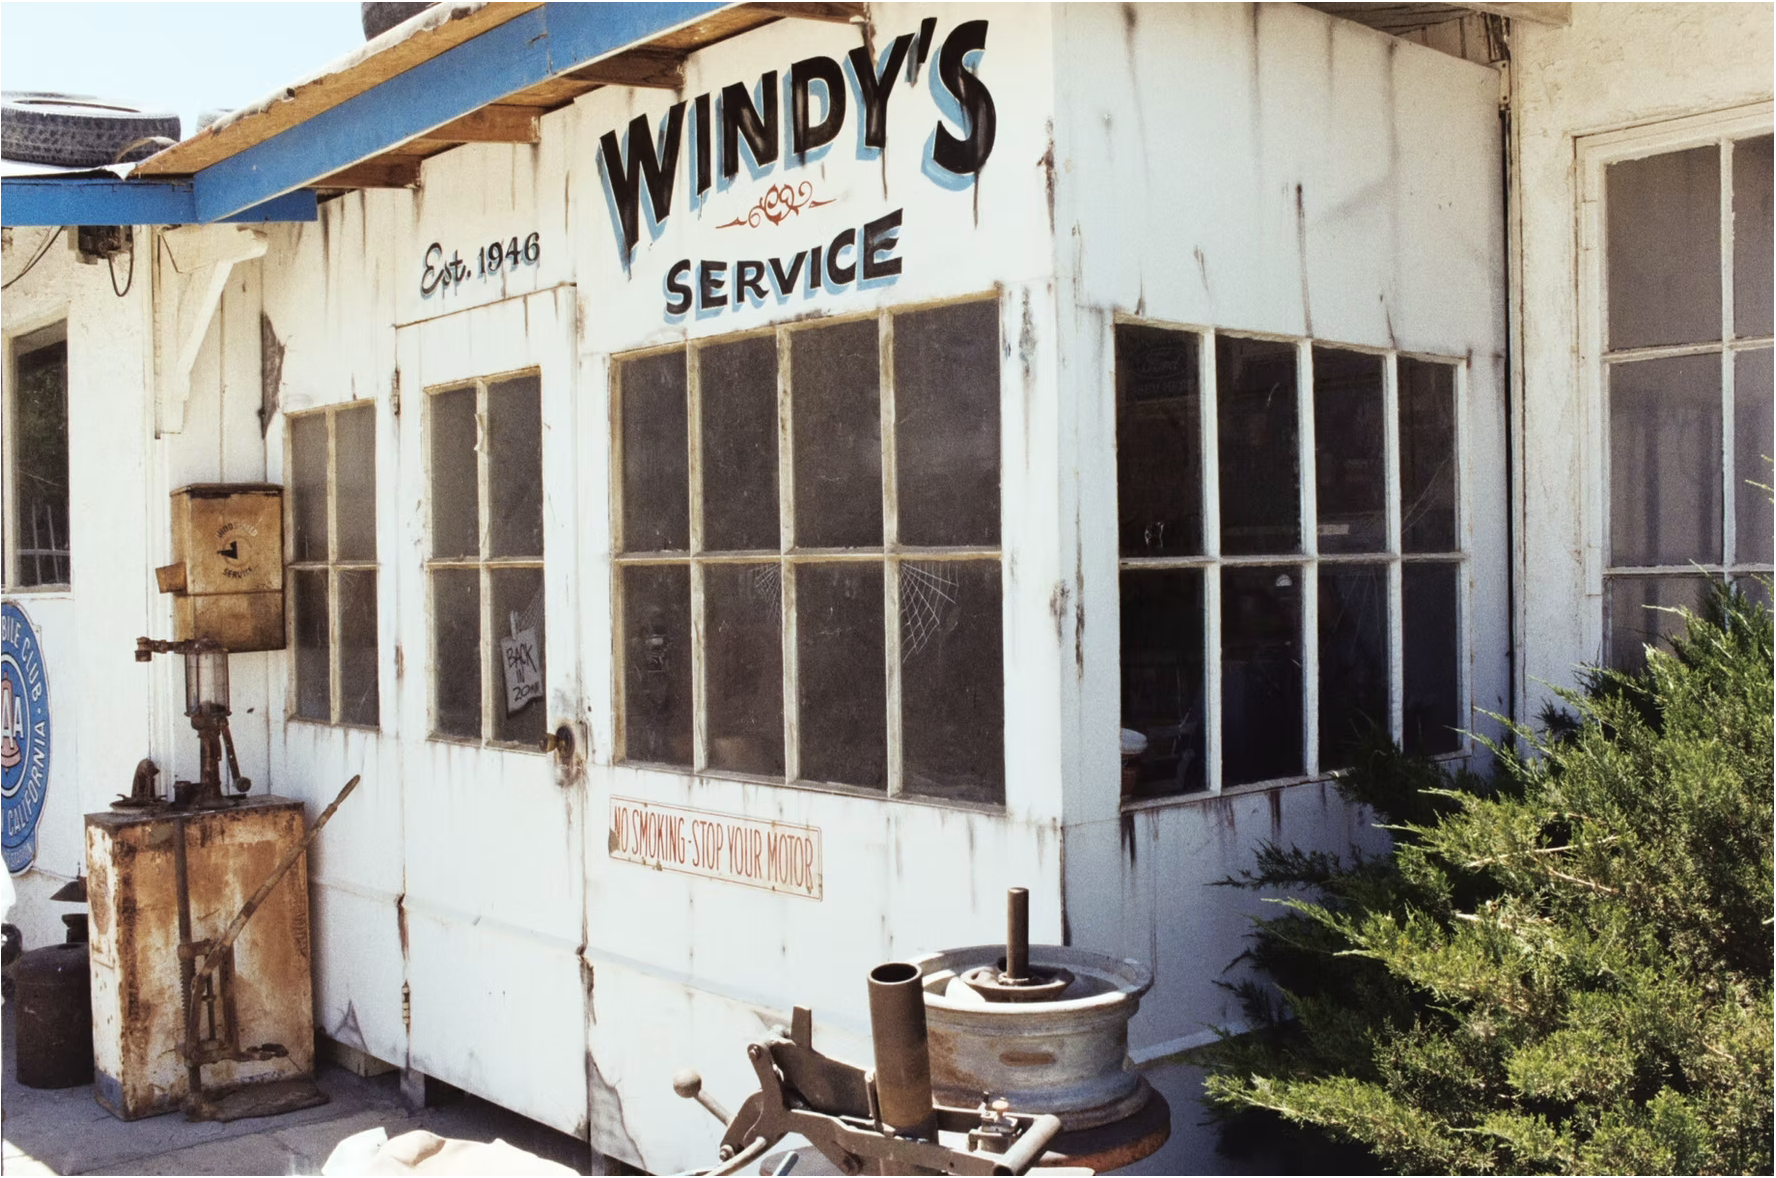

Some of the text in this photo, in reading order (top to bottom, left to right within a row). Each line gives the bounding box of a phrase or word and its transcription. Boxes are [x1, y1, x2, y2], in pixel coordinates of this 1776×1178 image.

[597, 17, 997, 263] WINDY'S
[420, 231, 541, 298] Est. 1946
[664, 208, 904, 322] SERVICE
[21, 637, 42, 702] CLUB
[506, 643, 537, 673] BACK
[7, 721, 46, 836] CALIFORNIA
[614, 806, 629, 853] NO
[727, 824, 763, 879] YOUR
[767, 831, 814, 890] MOTOR
